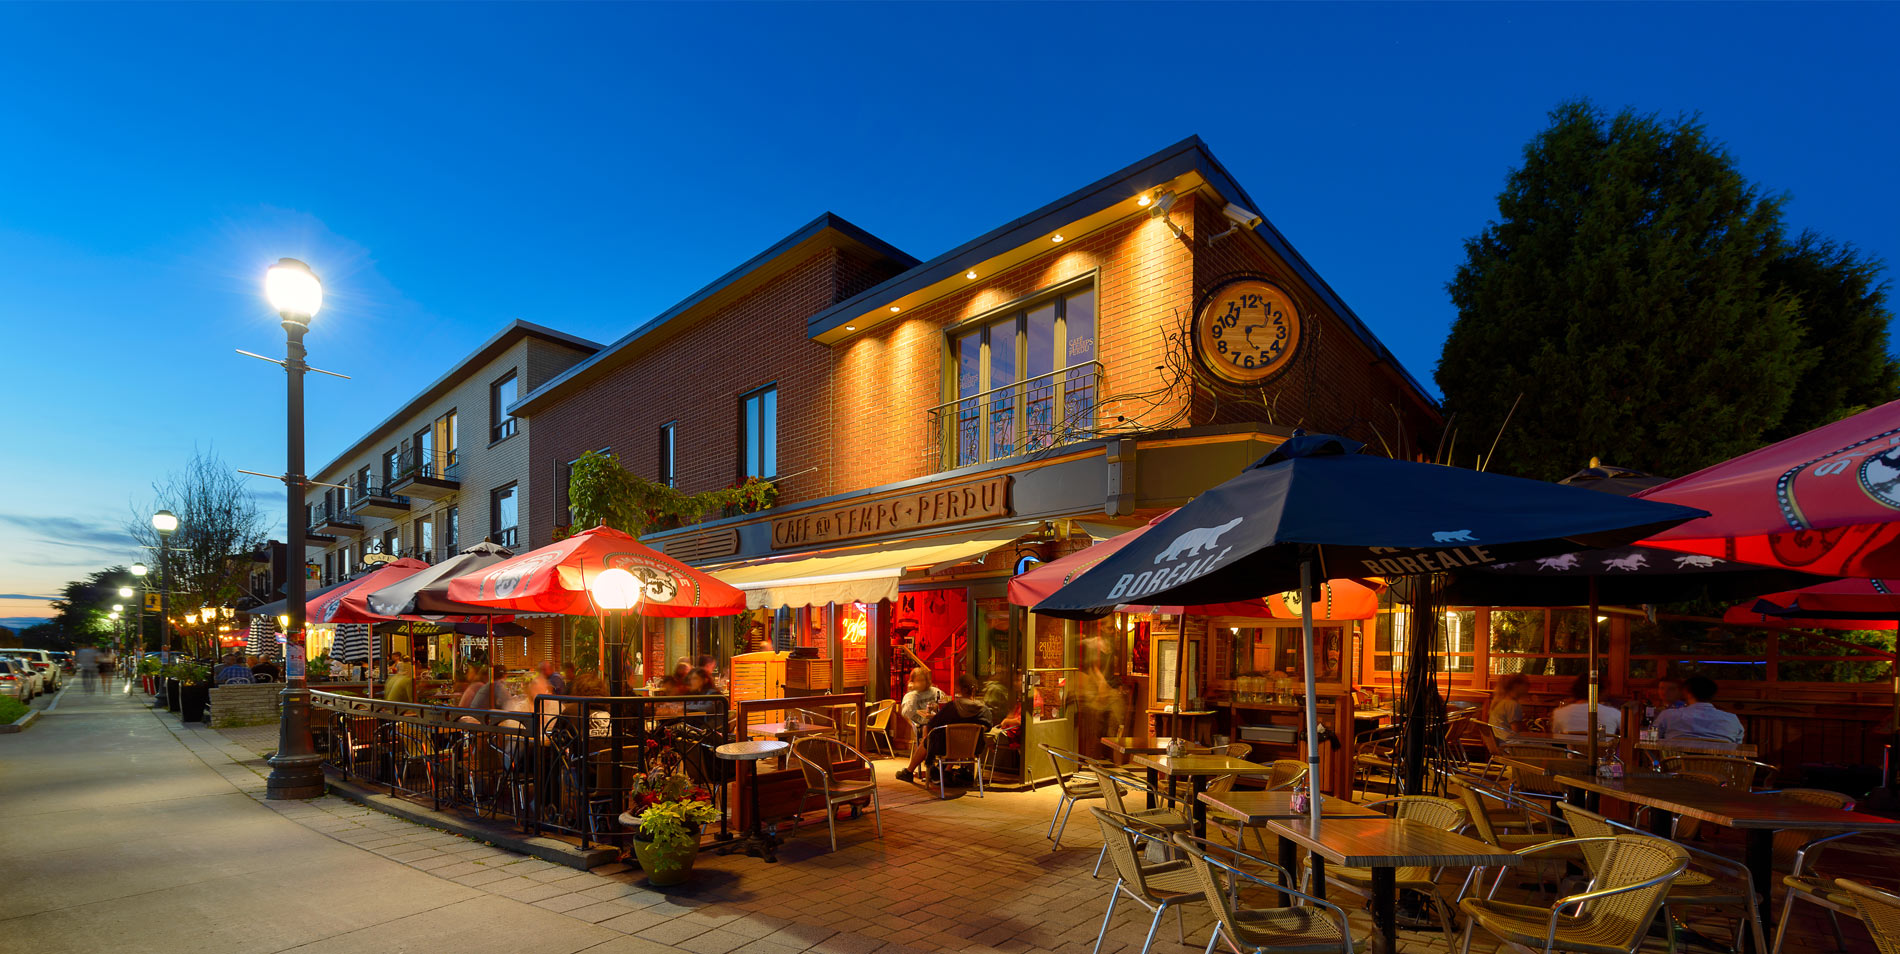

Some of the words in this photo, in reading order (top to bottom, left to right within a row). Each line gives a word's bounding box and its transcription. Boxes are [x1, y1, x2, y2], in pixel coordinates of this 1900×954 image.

[1240, 294, 1258, 308] 12
[1273, 311, 1283, 324] 2
[1212, 324, 1222, 338] 9
[1276, 326, 1286, 339] 3
[1217, 341, 1228, 354] 8
[1270, 340, 1280, 353] 4
[1231, 352, 1241, 364] 7
[1244, 355, 1254, 368] 6
[1260, 351, 1271, 363] 5
[835, 501, 900, 536] TEMPS
[917, 482, 997, 523] PERDU
